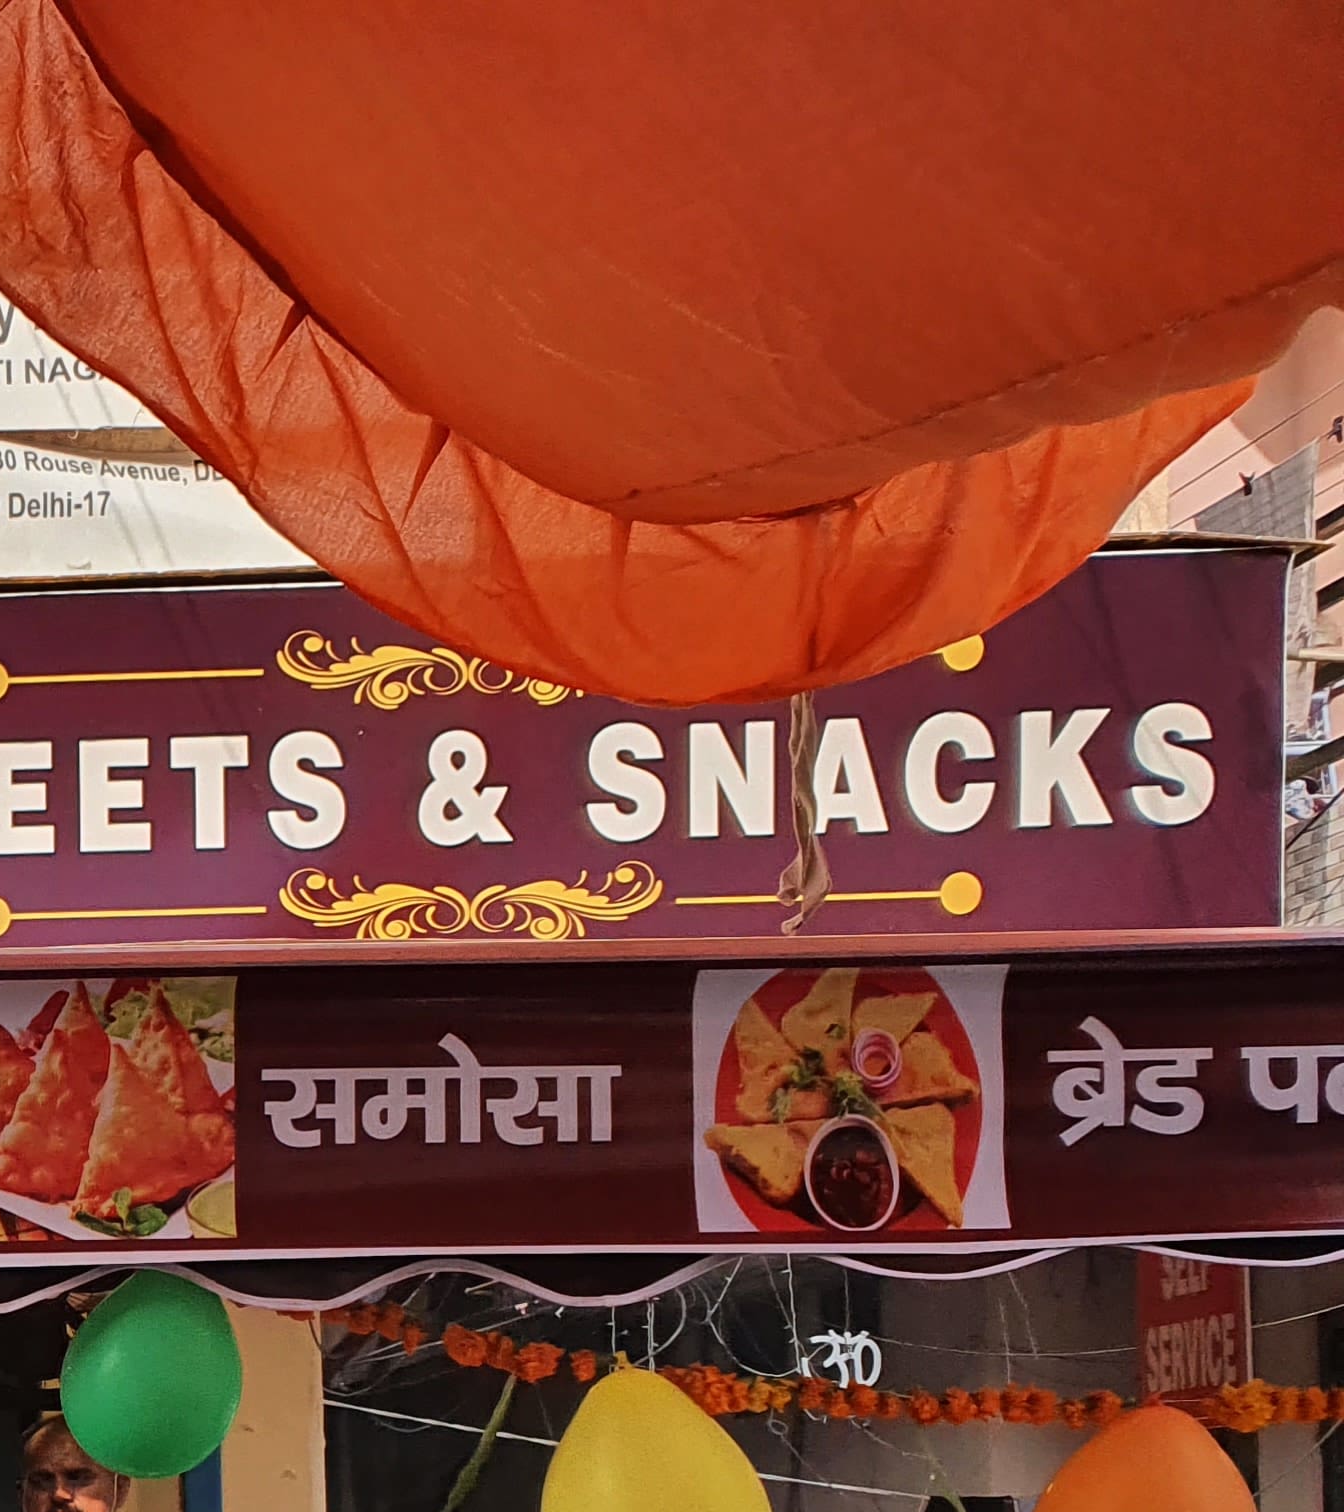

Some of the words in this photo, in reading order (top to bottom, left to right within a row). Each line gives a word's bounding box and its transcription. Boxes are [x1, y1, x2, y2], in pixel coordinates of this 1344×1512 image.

[24, 357, 109, 384] NAG
[7, 490, 112, 520] Delhi-17
[24, 450, 94, 476] Rouse
[99, 459, 189, 486] Avenue,
[416, 728, 516, 847] &
[585, 702, 1218, 847] SNACKS
[261, 1033, 622, 1148] समोसा
[1046, 1015, 1214, 1147] ब्रेड
[1145, 1312, 1237, 1393] SERVICE
